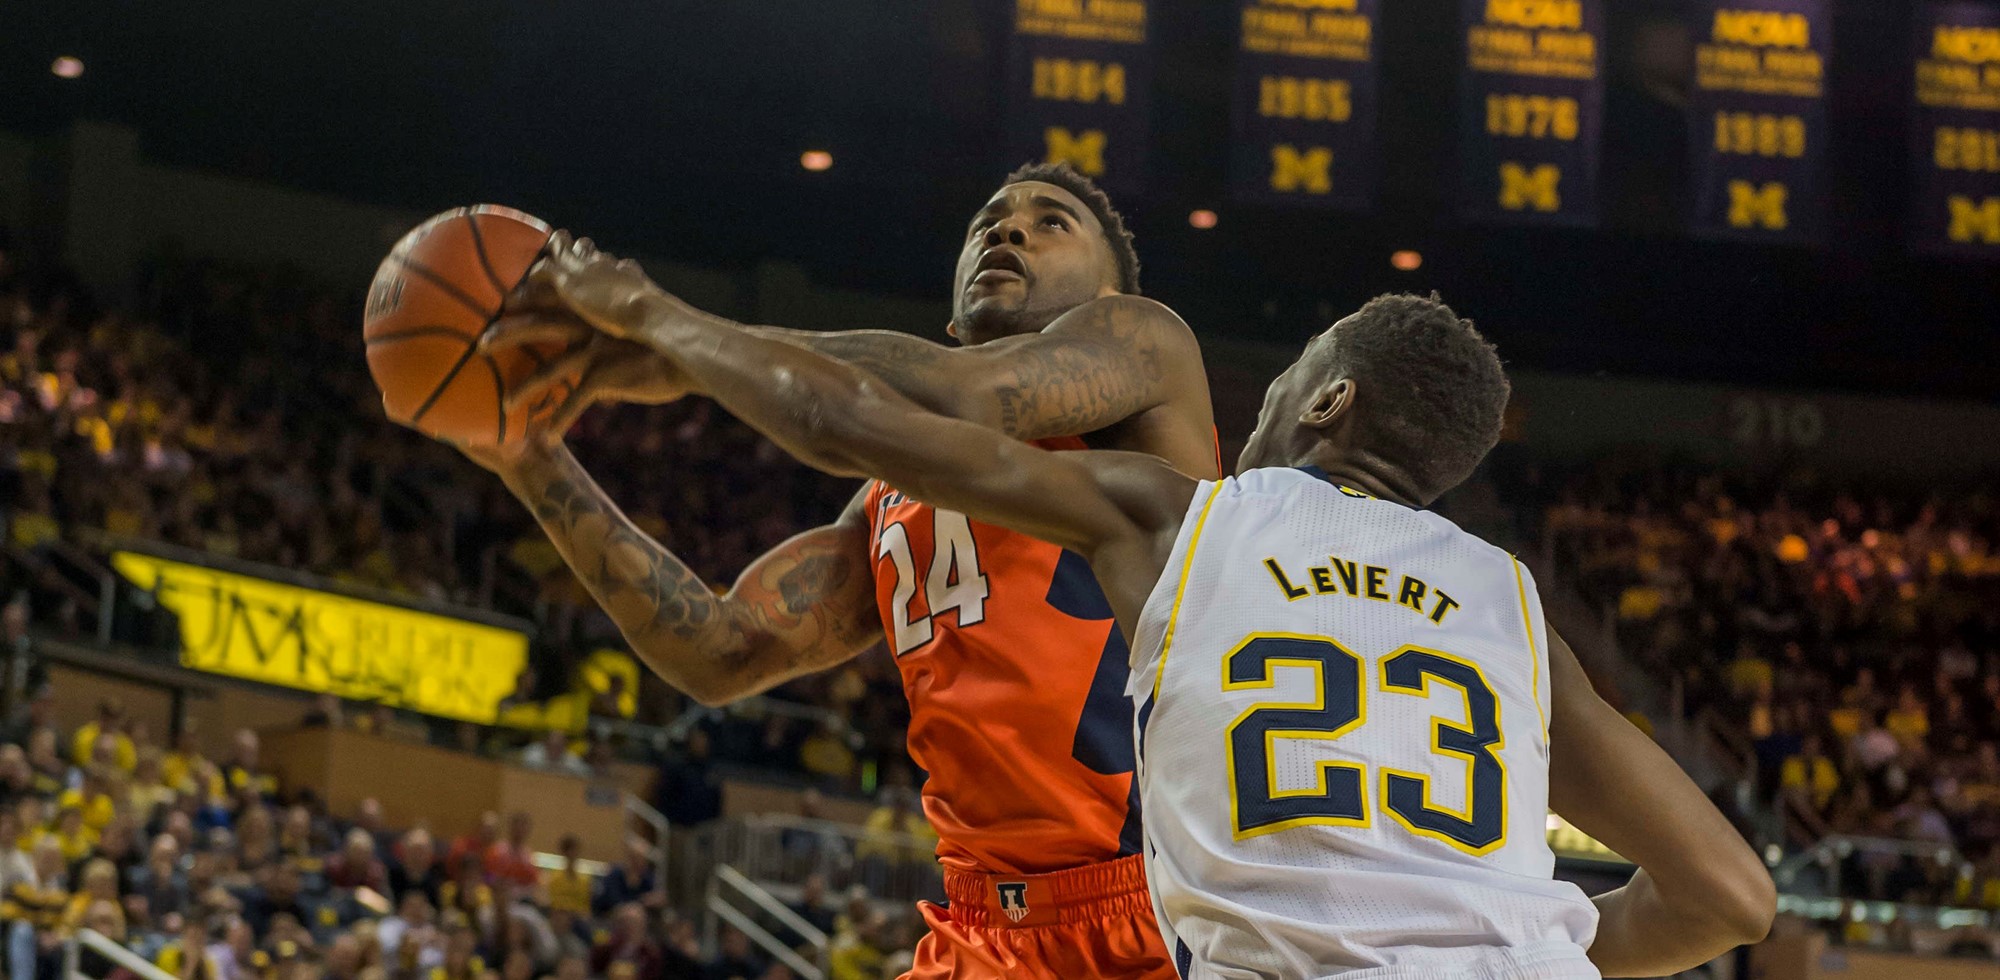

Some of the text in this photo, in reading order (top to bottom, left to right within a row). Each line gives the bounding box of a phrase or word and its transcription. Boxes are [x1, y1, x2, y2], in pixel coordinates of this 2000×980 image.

[1713, 10, 1809, 47] NCAA
[1932, 26, 2000, 63] NCA
[1486, 94, 1579, 141] 1976
[1045, 126, 1106, 175] M
[1270, 144, 1333, 193] M
[1933, 126, 2000, 173] 201
[1498, 162, 1561, 213] M
[1727, 179, 1788, 230] M
[1948, 195, 2000, 244] M
[879, 507, 990, 657] 24
[1221, 631, 1509, 858] 23
